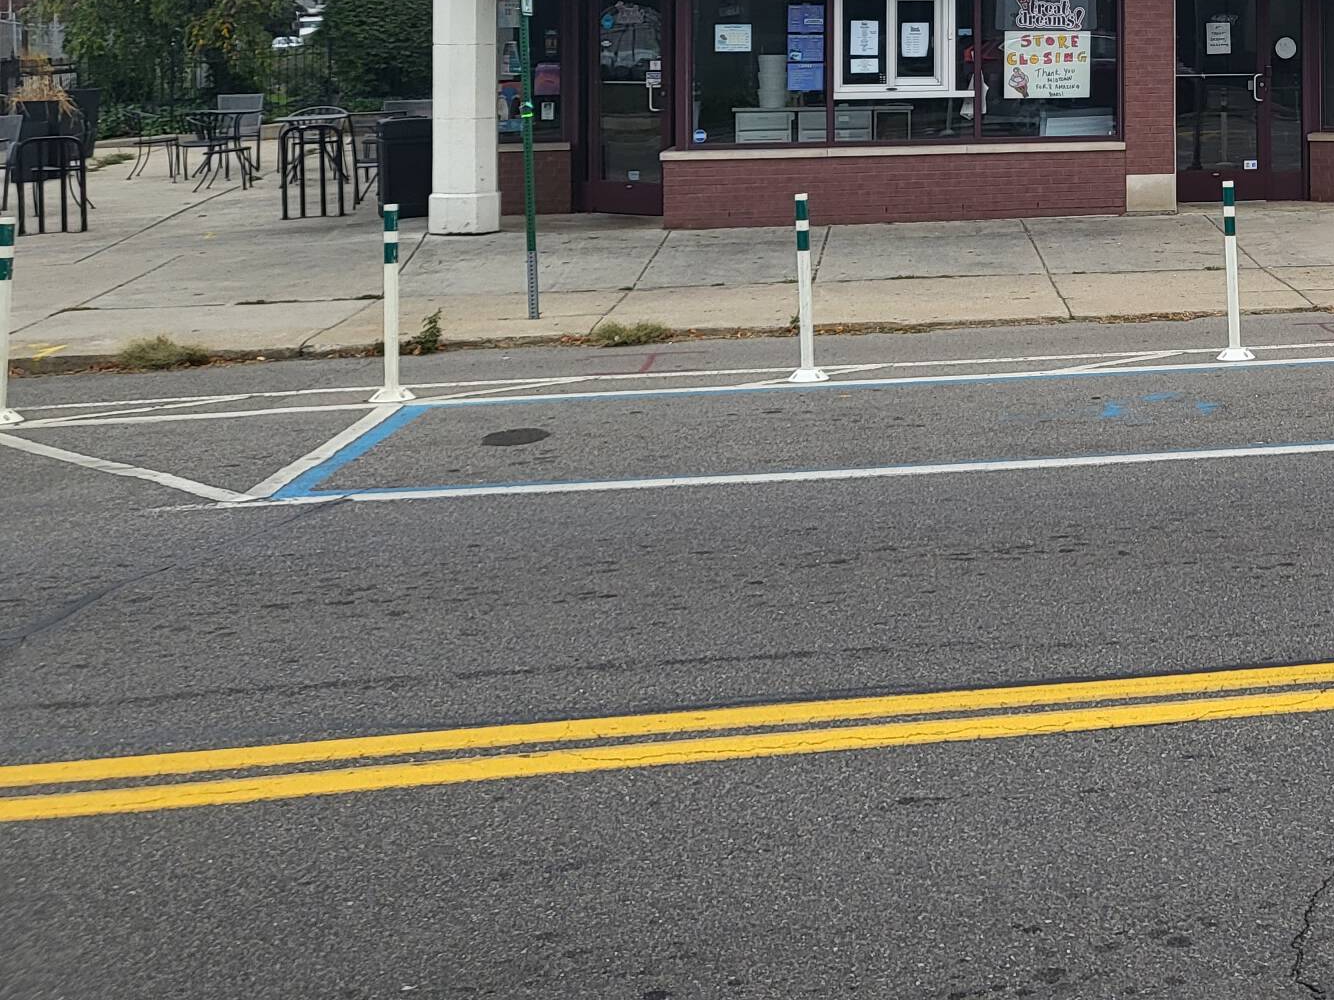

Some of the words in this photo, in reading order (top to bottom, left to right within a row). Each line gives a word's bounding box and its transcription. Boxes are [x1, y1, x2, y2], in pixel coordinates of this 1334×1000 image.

[1016, 7, 1085, 30] dreams!
[1021, 34, 1079, 49] STORE
[1007, 51, 1087, 65] CLOSING
[1035, 68, 1060, 78] Thank
